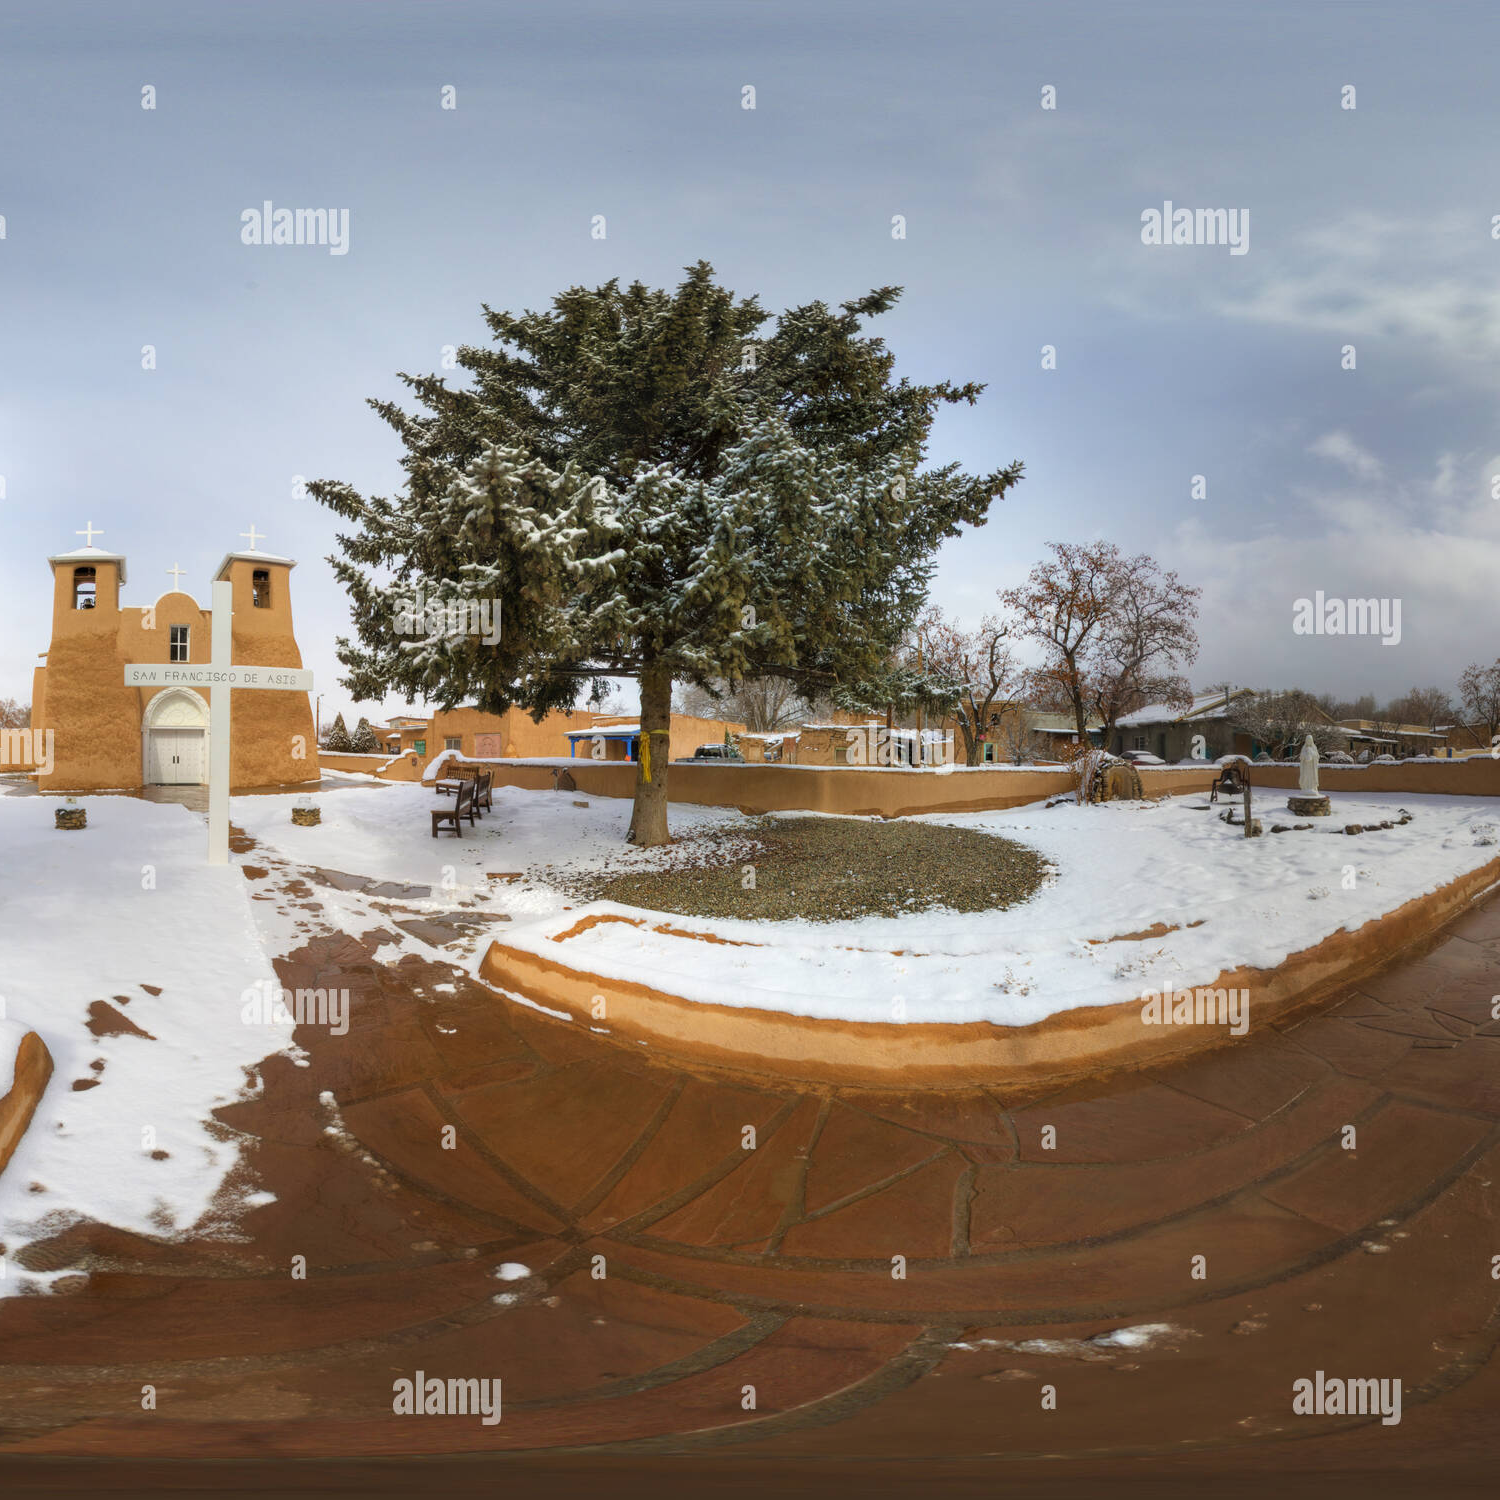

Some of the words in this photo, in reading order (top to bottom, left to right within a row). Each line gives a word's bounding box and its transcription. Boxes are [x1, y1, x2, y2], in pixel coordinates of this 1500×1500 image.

[133, 671, 156, 681] SAN
[164, 671, 237, 683] FRANCISCO
[244, 673, 258, 683] DE
[267, 674, 297, 685] ASIS
